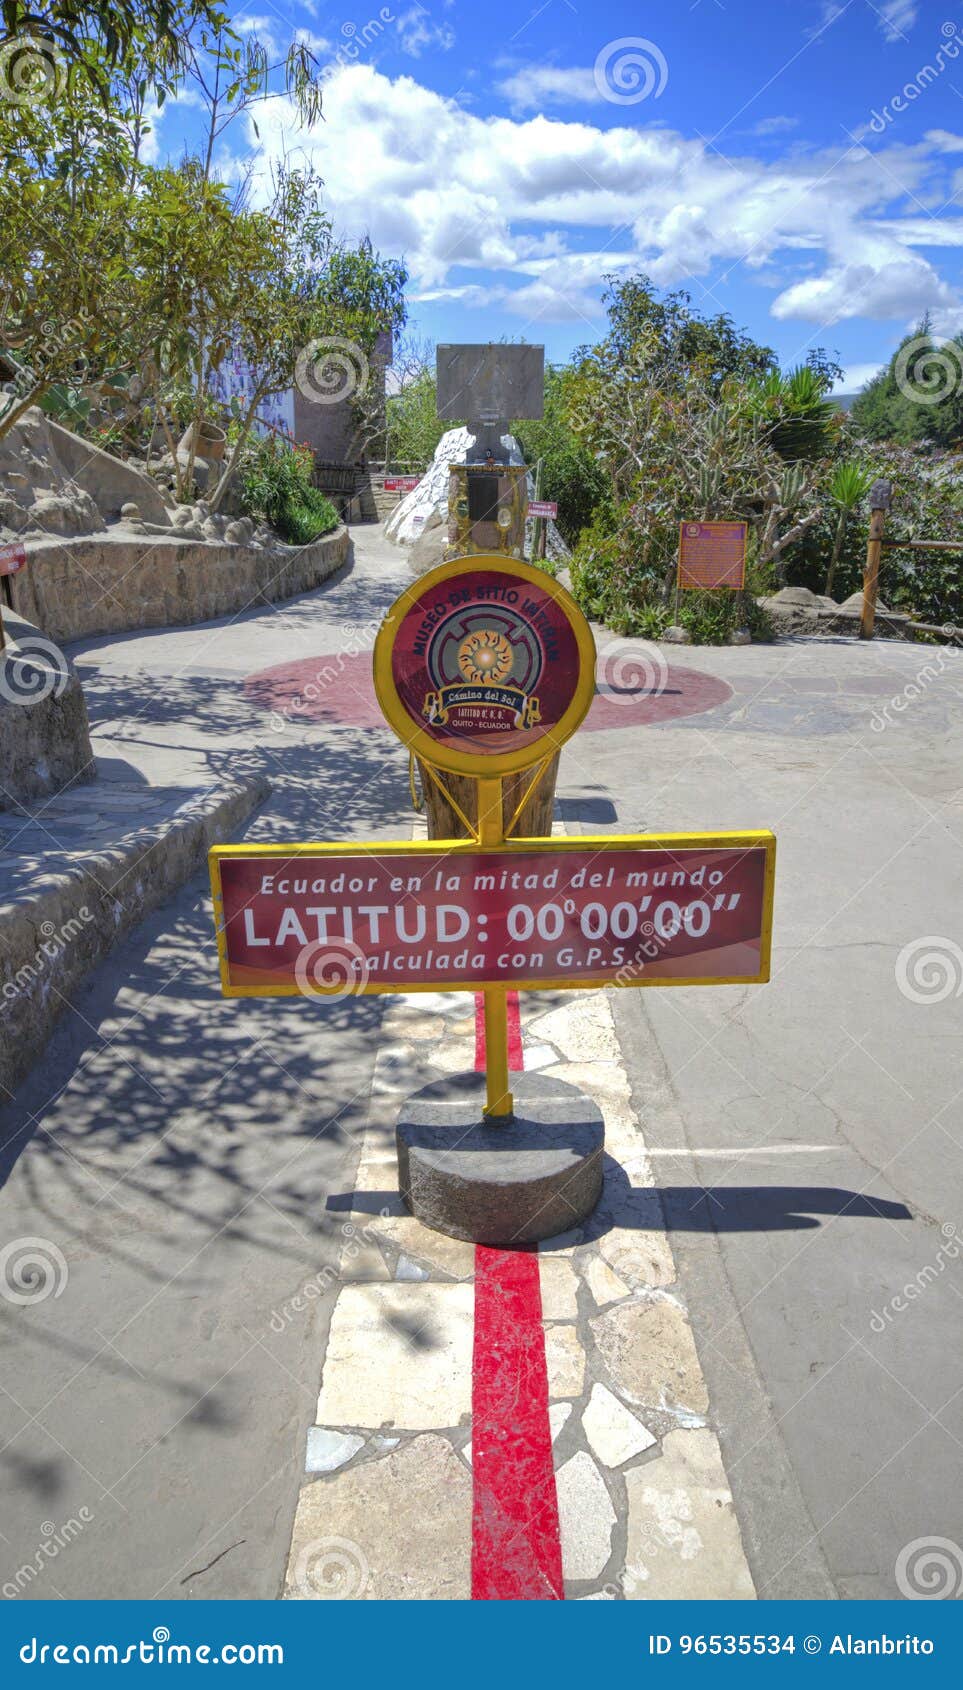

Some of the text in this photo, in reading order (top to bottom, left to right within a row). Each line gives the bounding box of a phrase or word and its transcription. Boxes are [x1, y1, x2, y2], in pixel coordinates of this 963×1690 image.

[413, 603, 447, 657] MUSEO
[449, 590, 472, 607] DE
[476, 587, 519, 604] SITIO
[448, 690, 516, 706] Camino del Sol
[452, 719, 474, 727] QUITO
[479, 721, 511, 730] ECUADOR
[458, 708, 480, 718] LATITUD
[261, 863, 724, 894] Ecuador en la mitad del mundo
[243, 905, 488, 947] LATITUD:
[350, 946, 633, 971] calculada con G.P.S.
